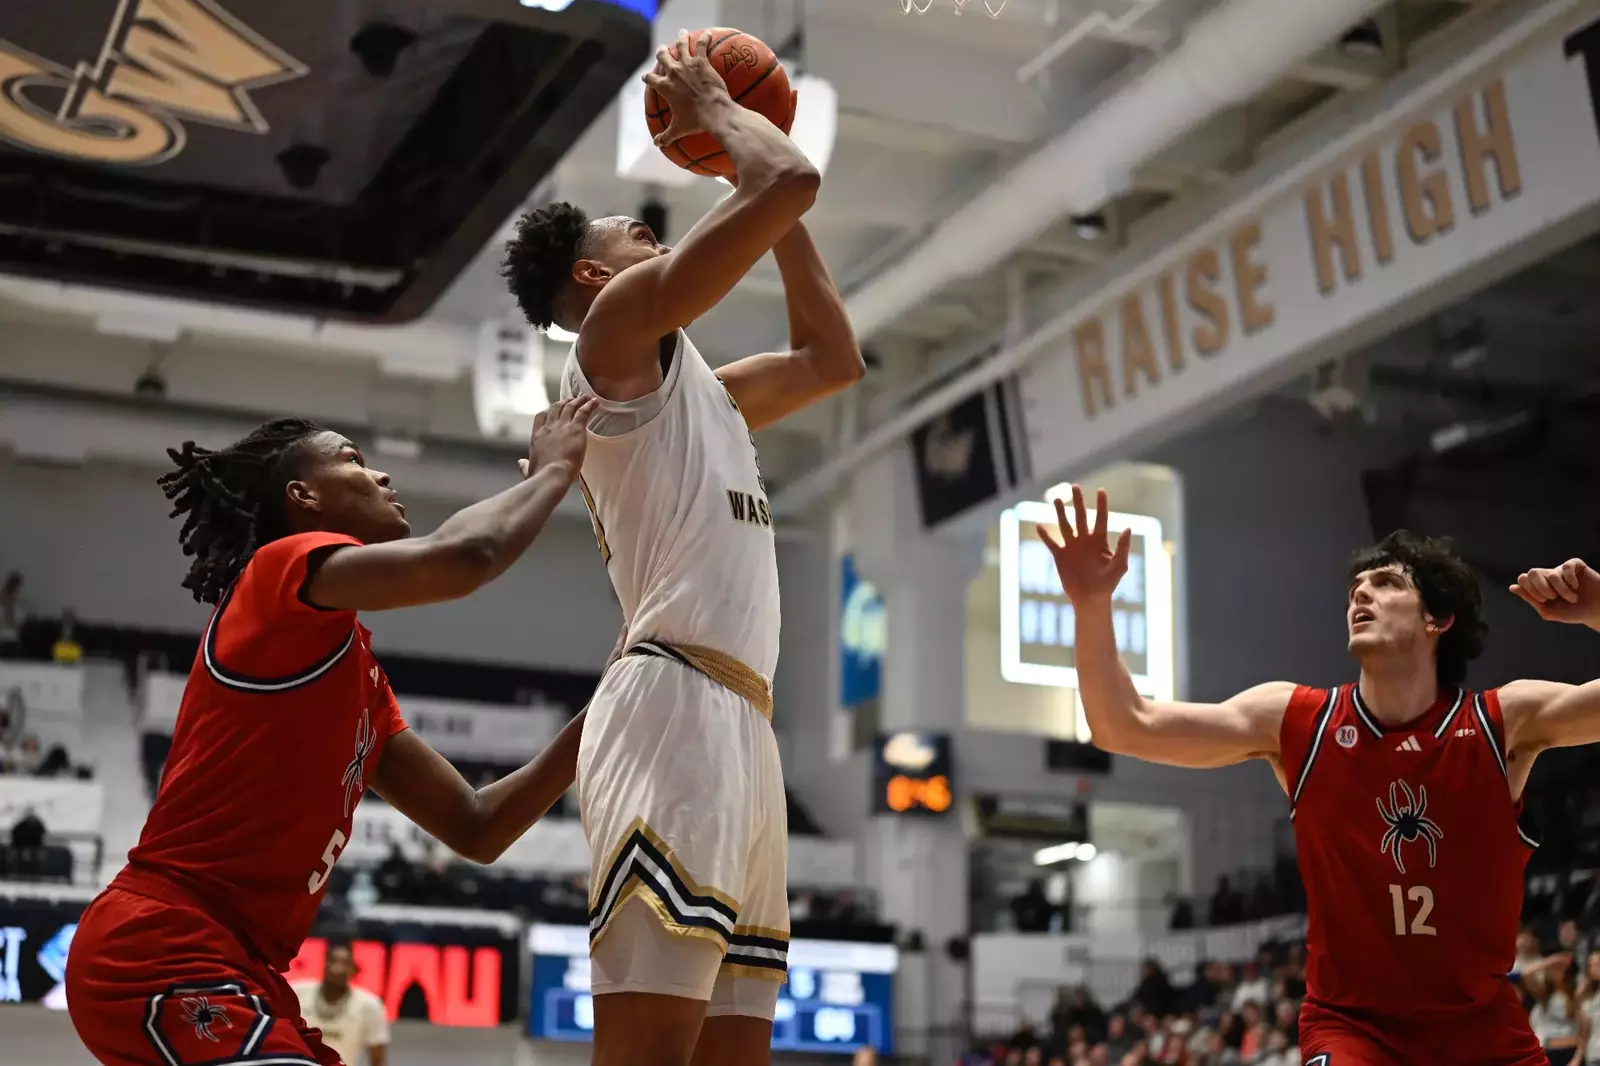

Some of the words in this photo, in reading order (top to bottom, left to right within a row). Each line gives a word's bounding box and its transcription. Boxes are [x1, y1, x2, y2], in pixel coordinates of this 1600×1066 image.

[1072, 217, 1274, 421] RAISE
[1306, 78, 1522, 296] HIGH
[727, 488, 774, 532] WAS
[307, 828, 346, 895] 5
[1388, 883, 1438, 936] 12
